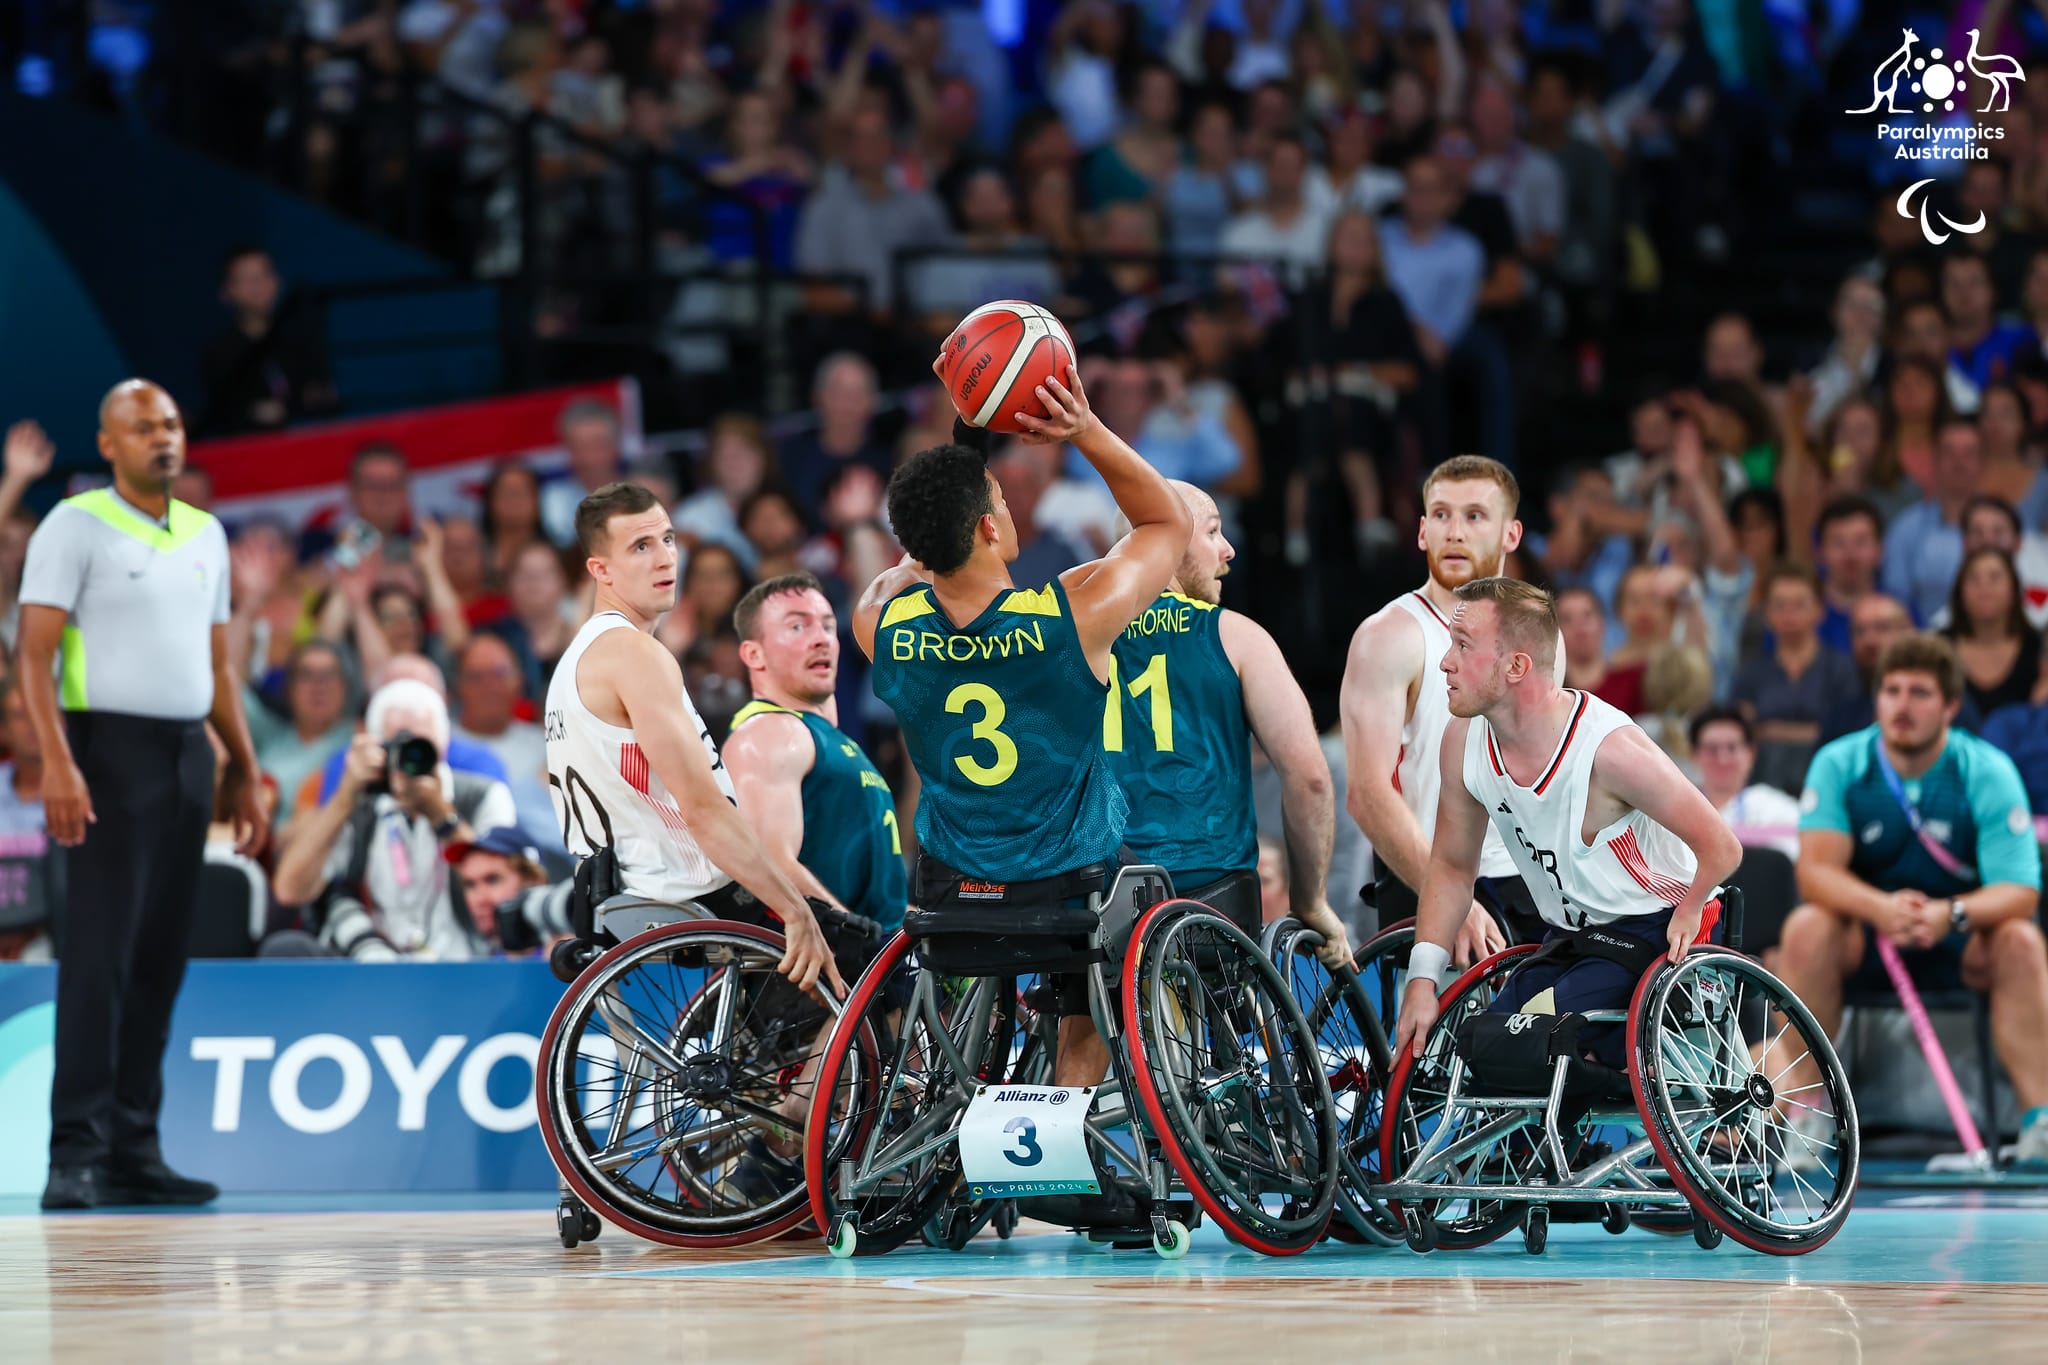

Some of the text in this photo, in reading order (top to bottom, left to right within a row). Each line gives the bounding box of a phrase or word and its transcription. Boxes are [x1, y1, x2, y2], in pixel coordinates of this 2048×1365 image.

[960, 351, 992, 401] molten
[892, 621, 1045, 662] BROWN
[944, 682, 1019, 786] 3
[959, 880, 1006, 893] Melrose
[994, 1090, 1048, 1103] Allianz
[1002, 1116, 1043, 1167] 3
[1008, 1183, 1082, 1192] PARIS 2024
